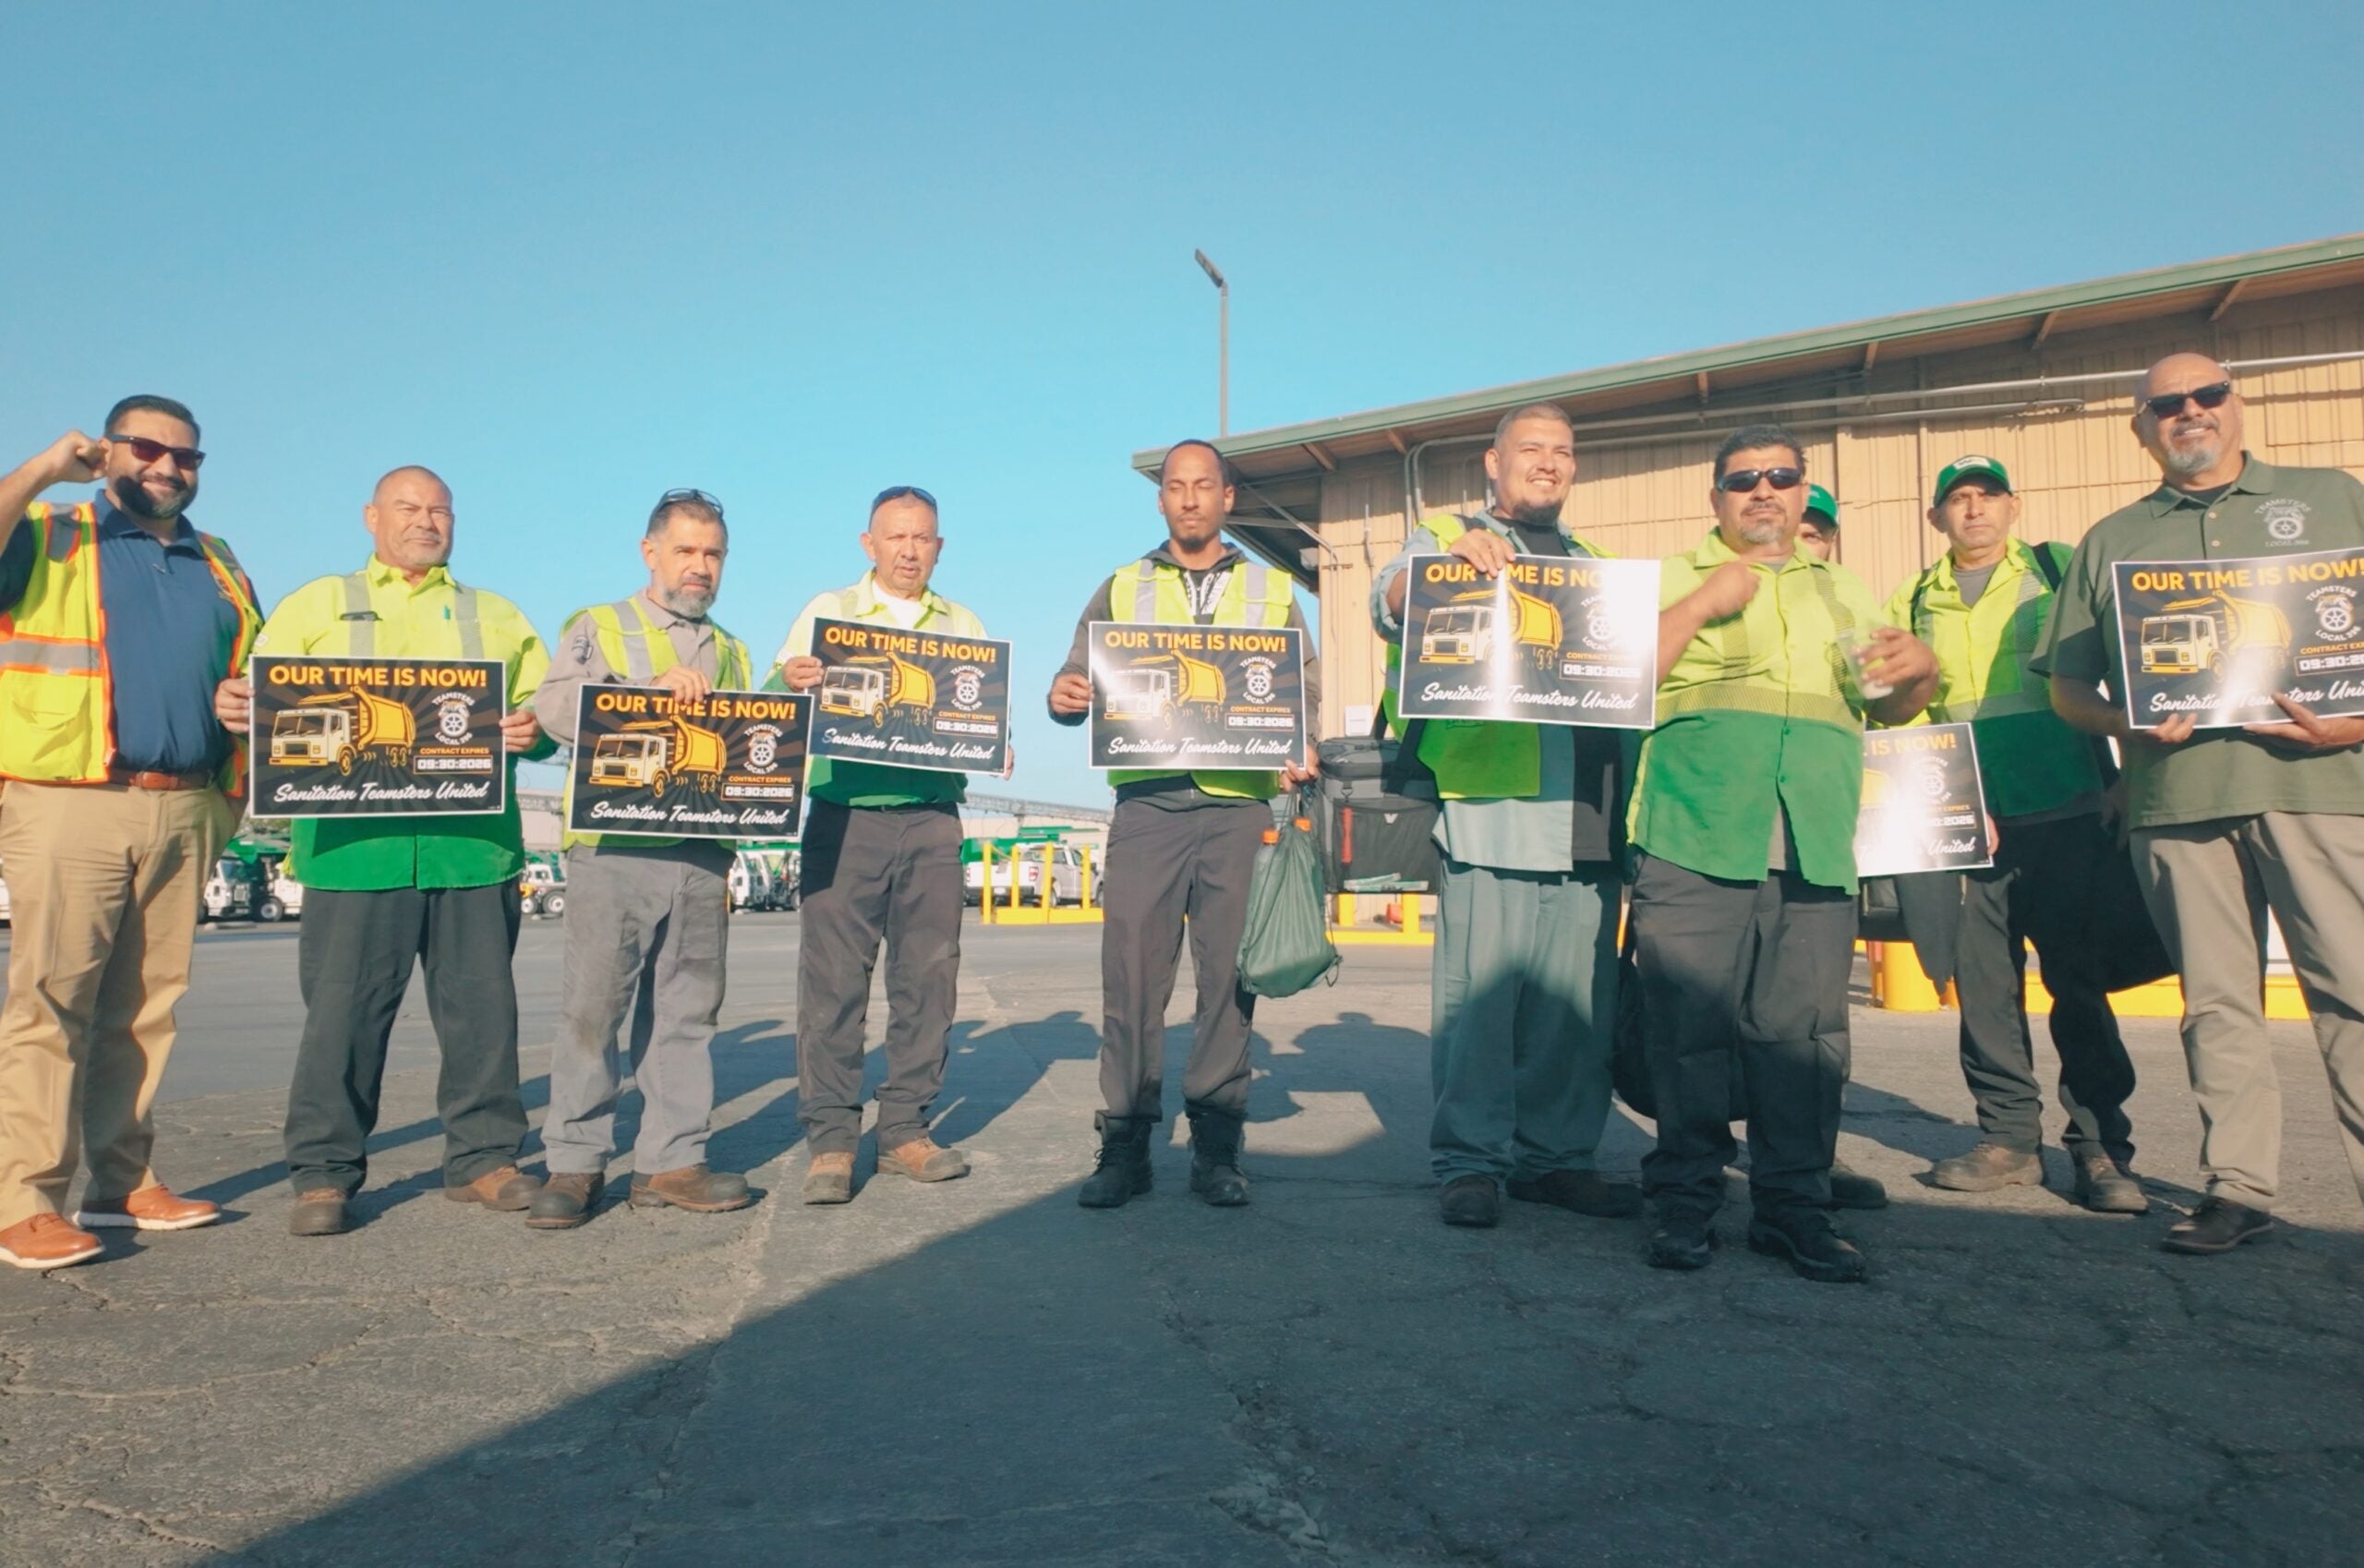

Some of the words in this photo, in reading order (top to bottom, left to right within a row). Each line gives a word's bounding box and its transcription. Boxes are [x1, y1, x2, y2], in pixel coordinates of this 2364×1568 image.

[1425, 563, 1477, 583] OUR
[1543, 567, 1564, 586] IS
[2131, 572, 2184, 591] OUR
[2189, 569, 2253, 590] TIME
[2257, 567, 2282, 586] IS
[2288, 558, 2364, 584] NOW!
[2306, 585, 2358, 602] TEAMSTERS
[826, 626, 868, 647] OUR
[871, 633, 918, 654] TIME
[921, 640, 938, 657] IS
[942, 643, 996, 663] NOW!
[1105, 631, 1150, 648] OUR
[1153, 633, 1202, 650] TIME
[1207, 634, 1225, 651] IS
[1230, 635, 1286, 653] NOW!
[2315, 629, 2347, 642] LOCAL
[2299, 644, 2347, 655] CONTRACT
[950, 664, 986, 679] TEAMSTERS
[1239, 656, 1277, 669] TEAMSTERS
[269, 666, 323, 685] OUR
[329, 667, 389, 686] TIME
[393, 669, 415, 686] IS
[420, 669, 487, 687] NOW!
[431, 692, 476, 706] TEAMSTERS
[951, 697, 972, 711] LOCAL
[1242, 692, 1265, 705] LOCAL
[1505, 684, 1578, 708] Teamsters
[1581, 690, 1639, 709] United
[2150, 692, 2220, 712] Sanitatio
[2238, 686, 2324, 708] Teamters
[2328, 680, 2364, 700] Uni
[596, 694, 646, 712] OUR
[711, 699, 730, 717] IS
[735, 701, 796, 720] NOW!
[938, 710, 971, 719] CONTRACT
[434, 731, 460, 745] LOCAL
[743, 723, 783, 738] TEAMSTERS
[821, 728, 887, 750] Sanitation
[887, 736, 947, 756] Teamsters
[949, 742, 996, 760] United
[1108, 736, 1176, 754] Sanitation
[1178, 737, 1242, 754] Teamsters
[1244, 738, 1292, 754] United
[1871, 740, 1890, 756] IS
[1894, 733, 1957, 754] NOW!
[743, 761, 766, 775] LOCAL
[273, 782, 357, 802] Sanitation
[358, 782, 432, 802] Teamsters
[436, 781, 489, 799] United
[591, 801, 668, 819] Sanitation
[666, 805, 738, 824] Teamsters
[739, 808, 790, 825] United
[1928, 836, 1976, 856] United
